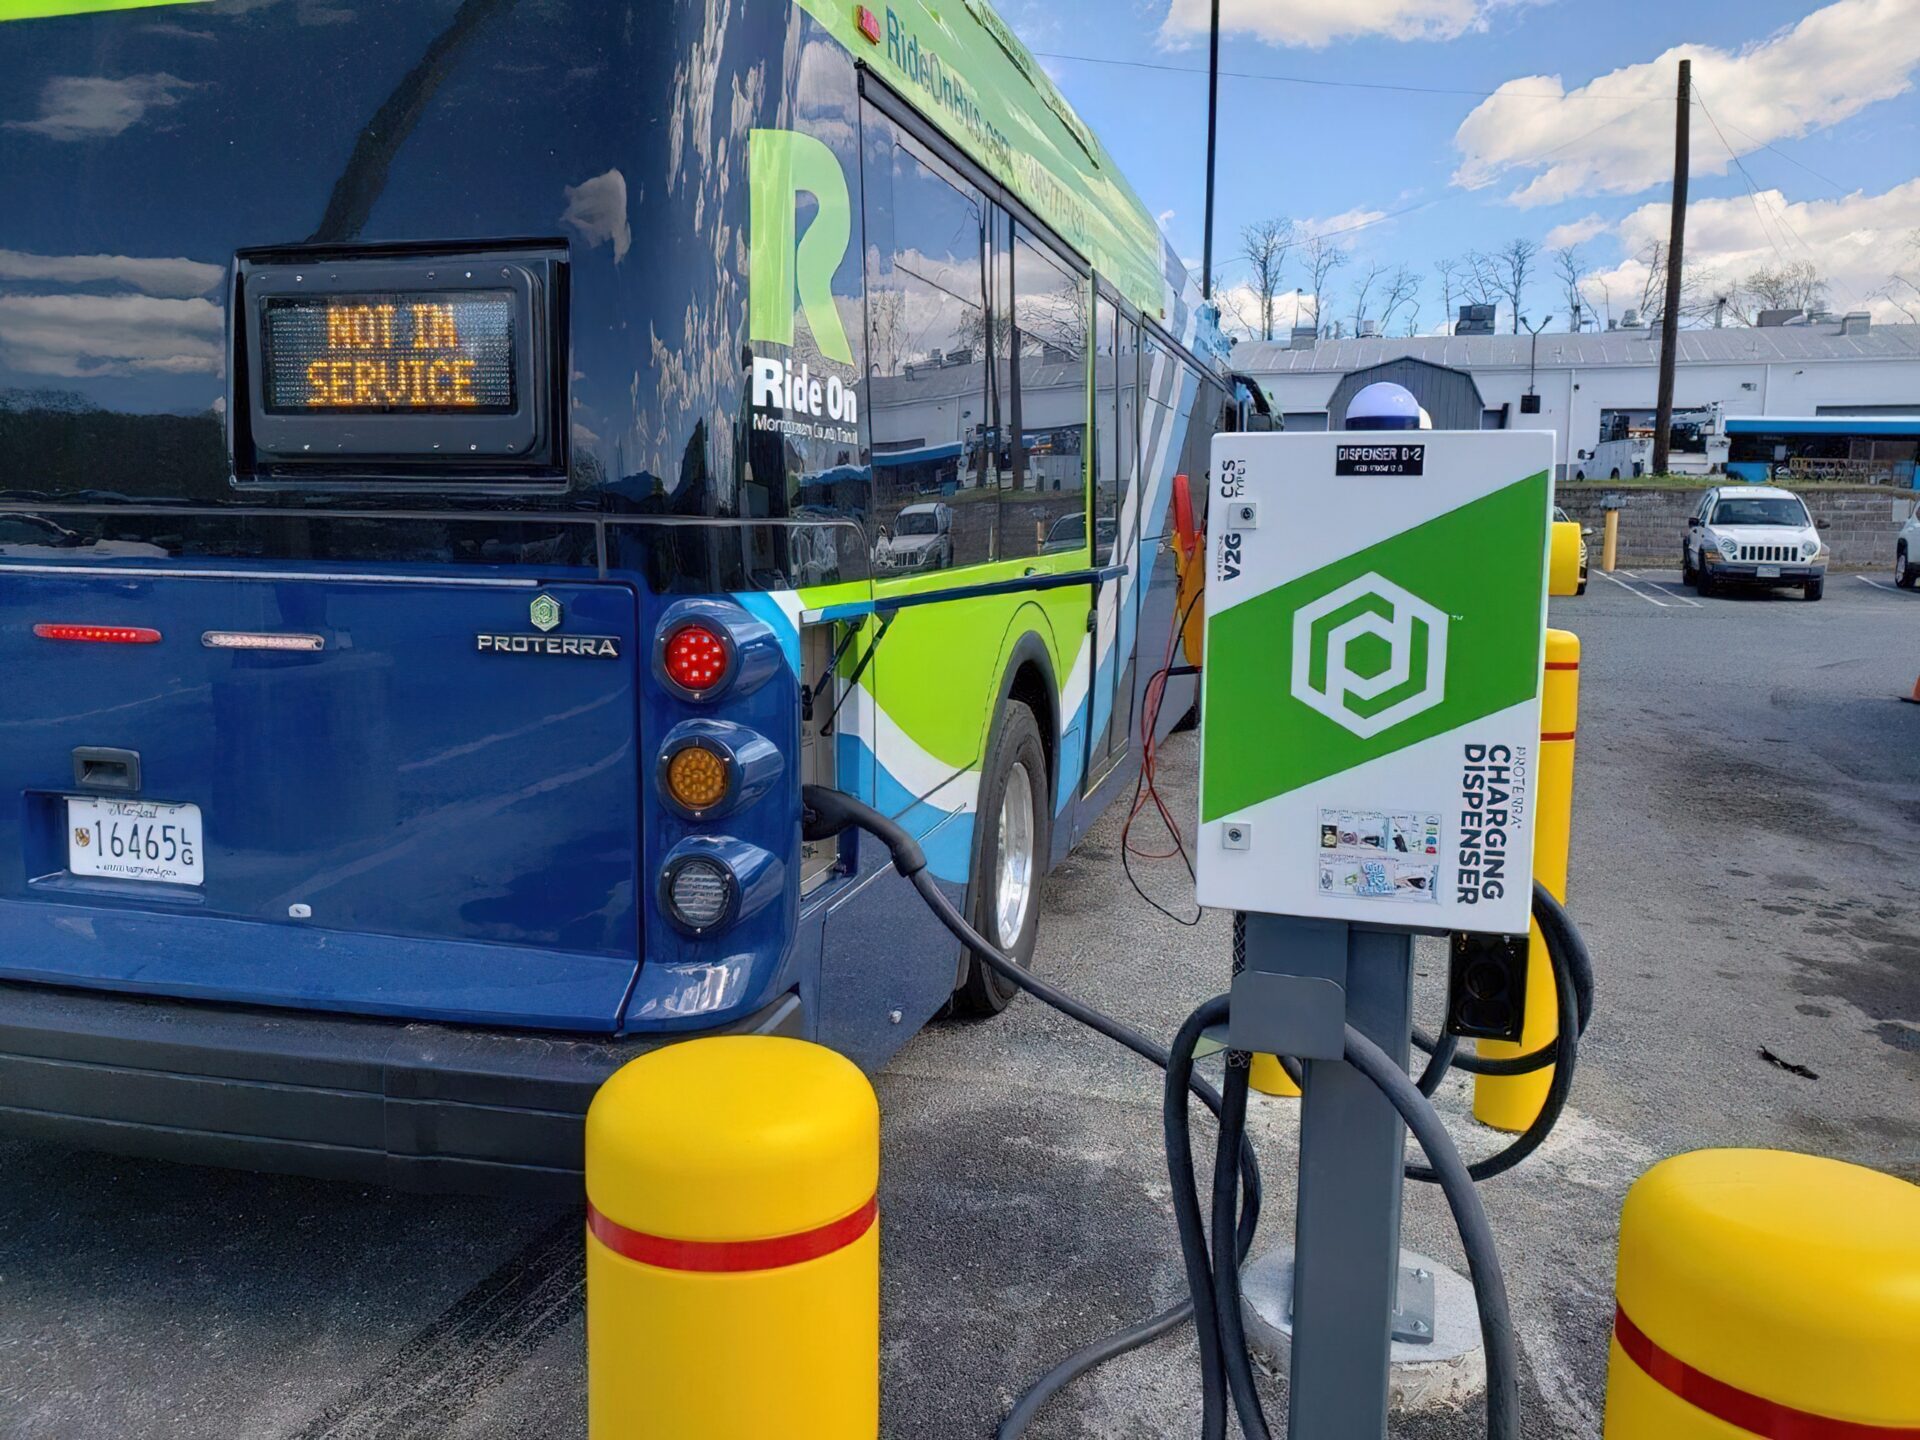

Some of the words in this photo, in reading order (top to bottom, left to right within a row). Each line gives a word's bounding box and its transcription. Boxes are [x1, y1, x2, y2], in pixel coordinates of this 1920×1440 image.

[328, 304, 395, 349] NOT
[412, 303, 458, 349] IN
[306, 360, 477, 405] SERVICE
[752, 356, 823, 417] Ride
[826, 375, 857, 423] On
[1338, 447, 1397, 461] DISPENSER
[1221, 459, 1236, 498] CCS
[1236, 467, 1245, 497] TYPE
[1223, 533, 1242, 582] V2G
[477, 635, 619, 657] PROTERRA
[1510, 746, 1526, 827] PROTERRA
[95, 820, 177, 861] 16465
[1457, 744, 1486, 905] DISPENSER
[1481, 744, 1511, 900] CHARGING
